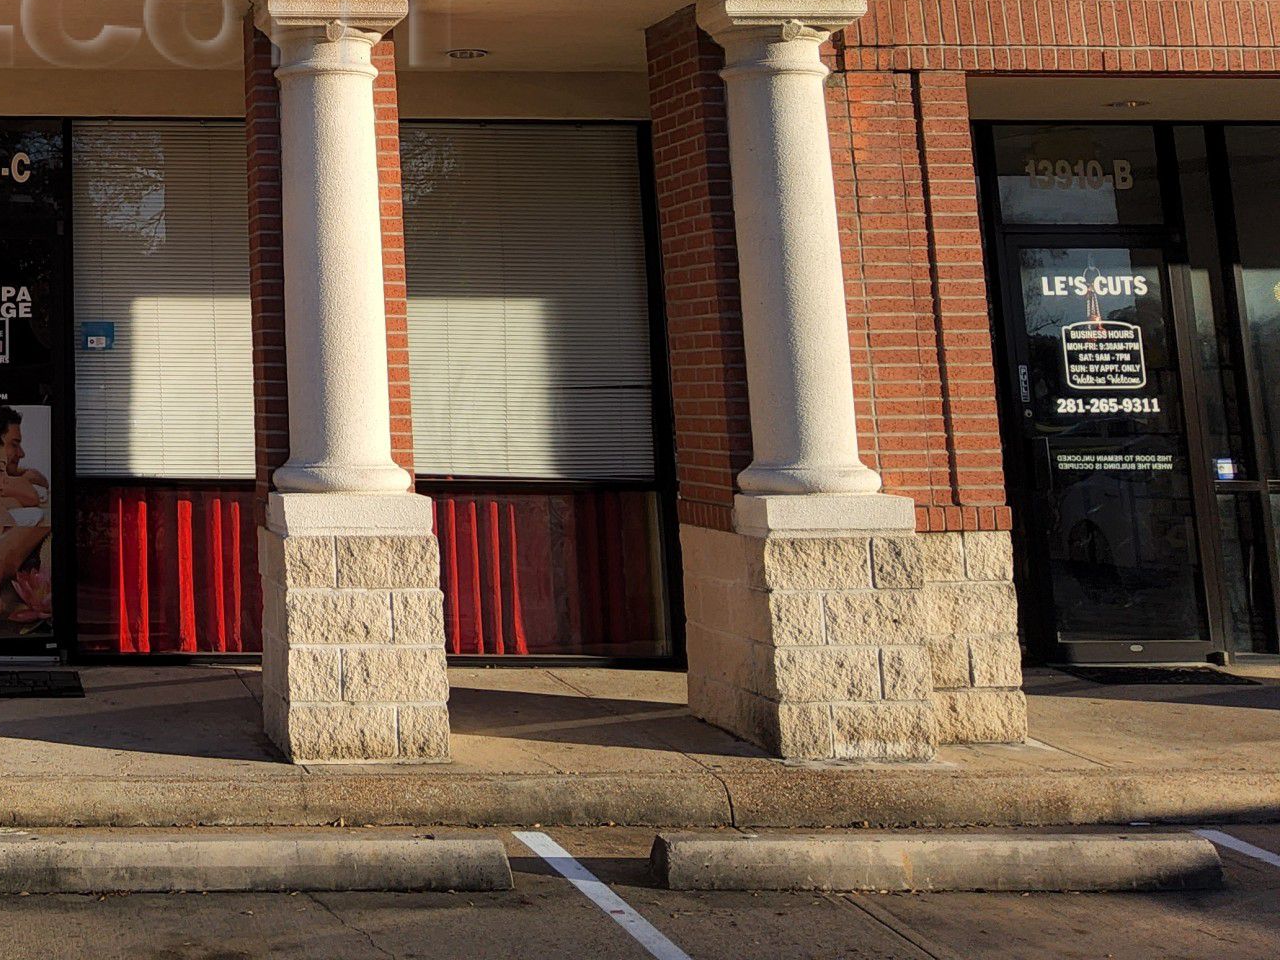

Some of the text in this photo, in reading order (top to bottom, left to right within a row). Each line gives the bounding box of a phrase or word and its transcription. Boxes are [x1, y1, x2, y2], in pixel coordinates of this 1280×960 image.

[1024, 159, 1135, 191] 13910-B
[1041, 275, 1149, 296] LE'S CUTS
[1070, 330, 1135, 339] BUSINESS HOURS
[1078, 352, 1095, 361] SAT:
[1070, 364, 1088, 373] SUN:
[1089, 364, 1100, 373] BY
[1121, 364, 1141, 373] ONLY
[1056, 398, 1161, 413] 281-265-9311
